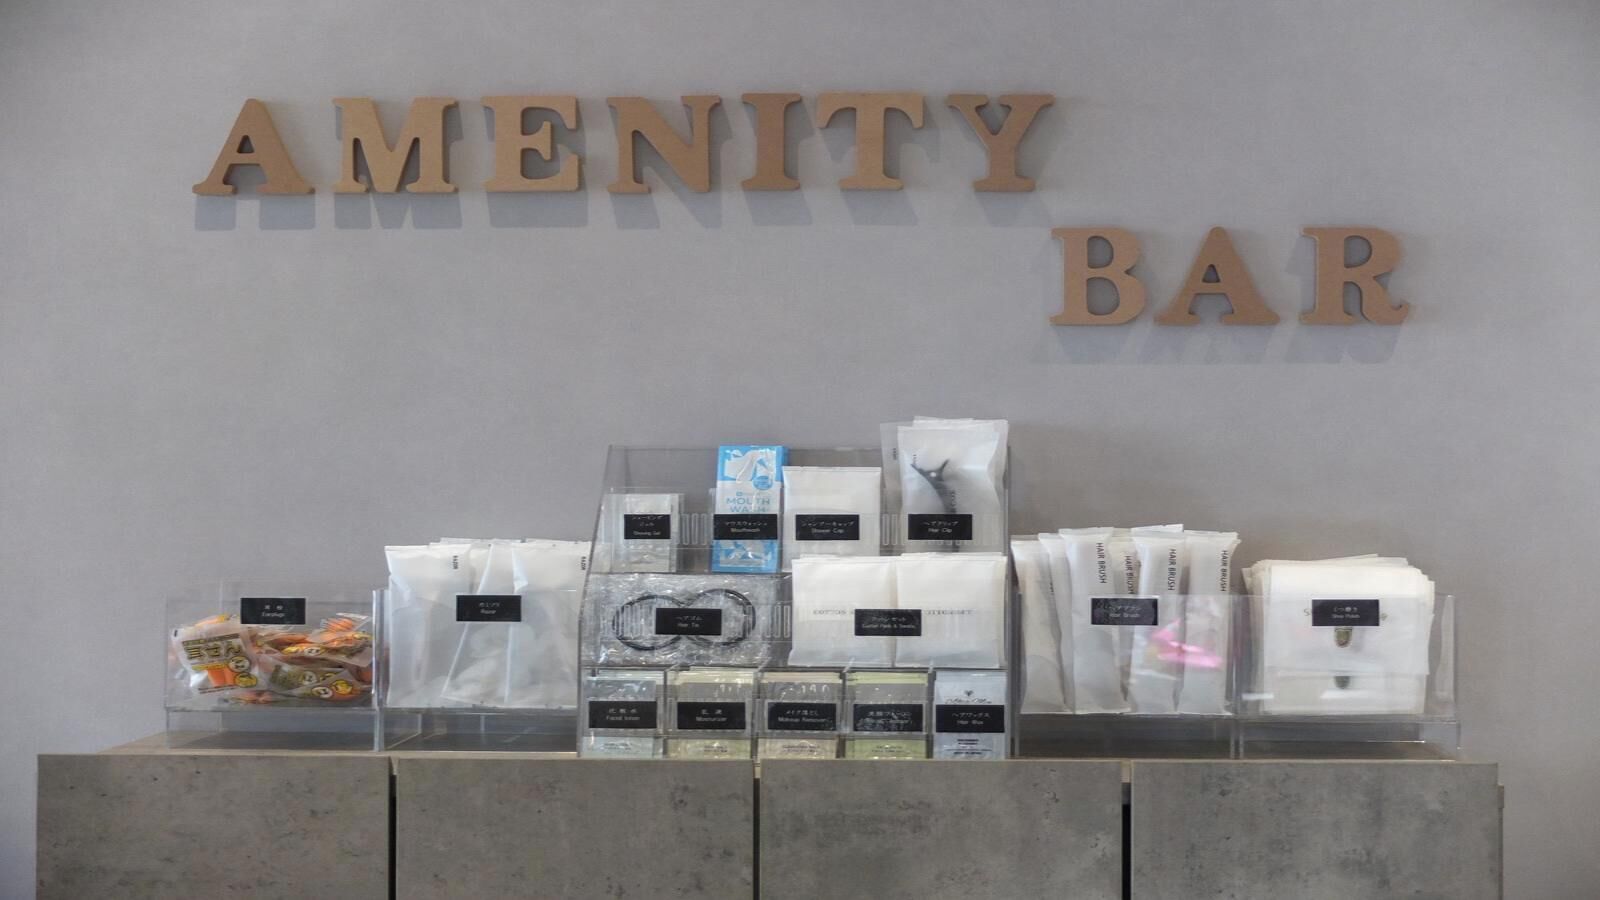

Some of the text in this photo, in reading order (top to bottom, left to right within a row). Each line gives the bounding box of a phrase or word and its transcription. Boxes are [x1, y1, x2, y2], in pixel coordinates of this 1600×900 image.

[193, 94, 1053, 195] AMENITY
[1050, 226, 1410, 326] BAR
[1095, 542, 1108, 585] HAIR BRUSH
[1124, 555, 1134, 571] HAIR
[1167, 548, 1177, 591] HAIR BRUSH
[1220, 549, 1229, 592] HAIR BRUSH
